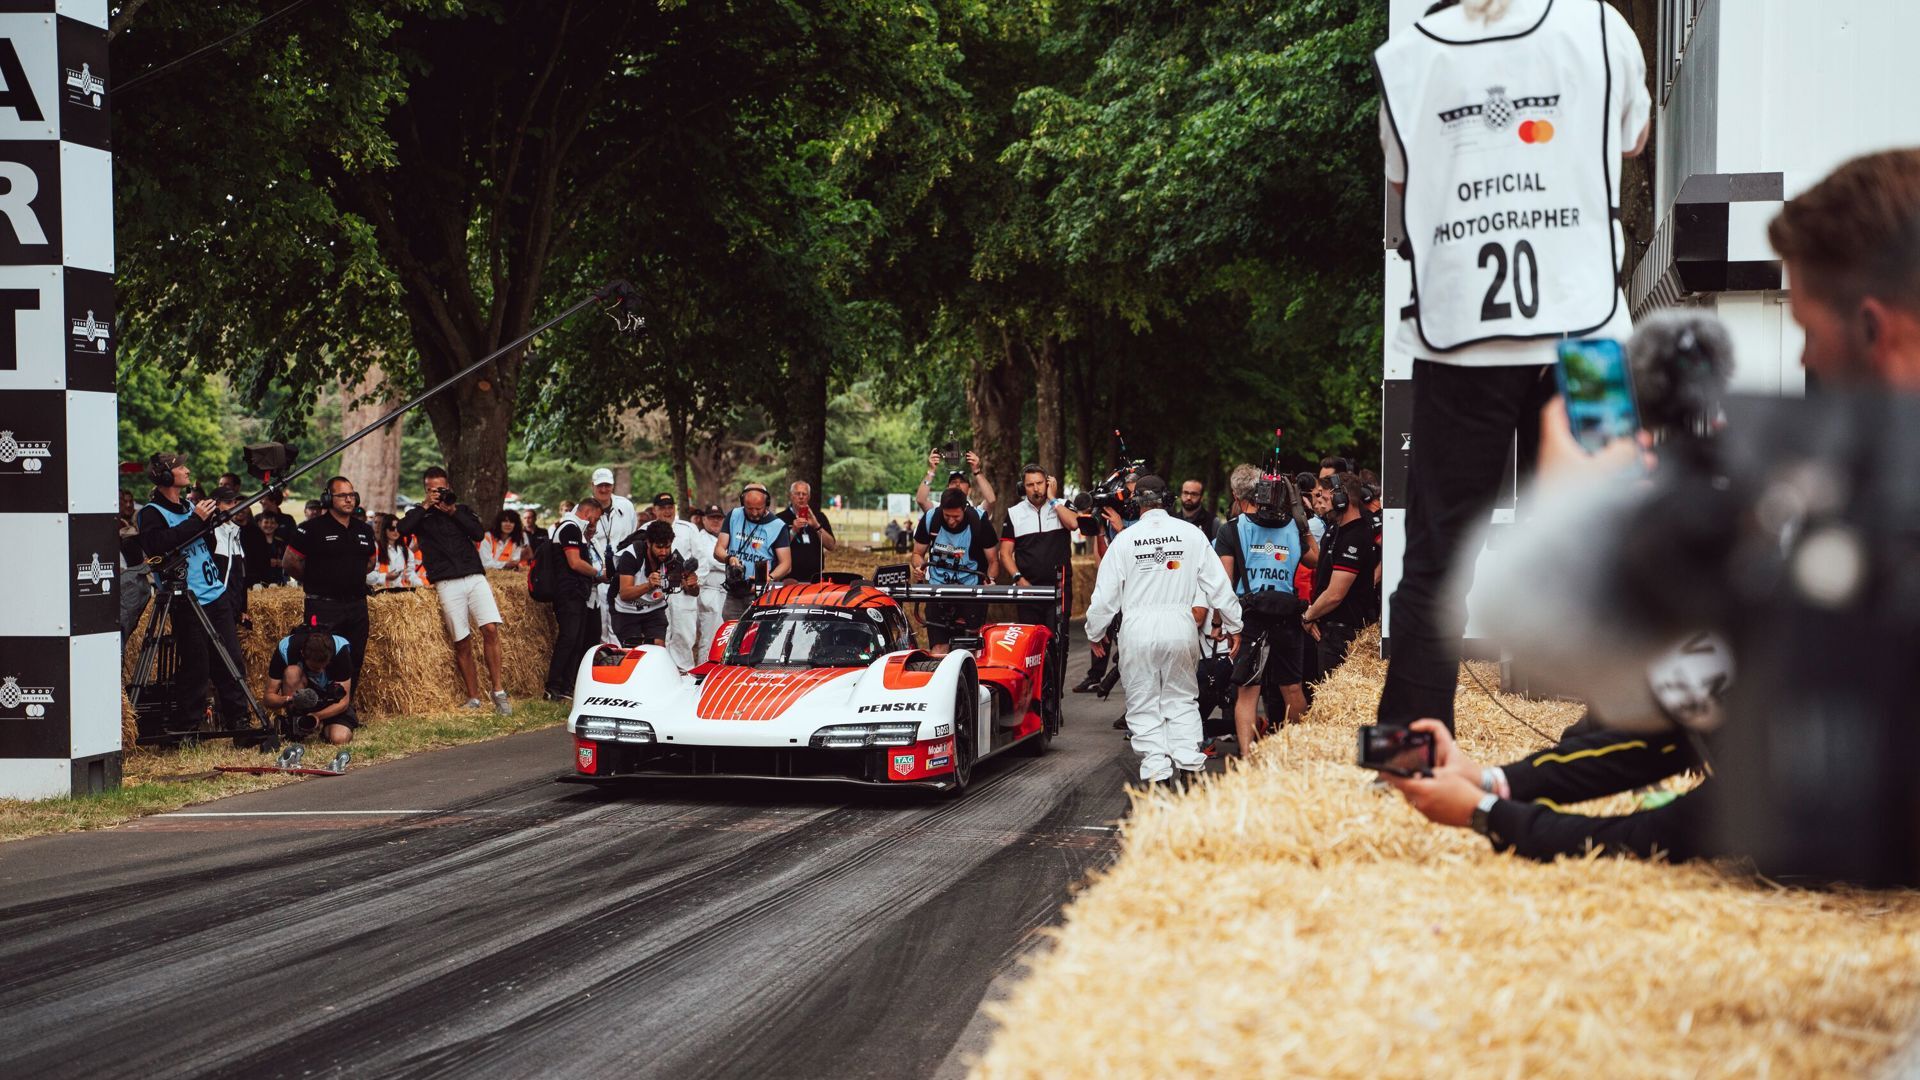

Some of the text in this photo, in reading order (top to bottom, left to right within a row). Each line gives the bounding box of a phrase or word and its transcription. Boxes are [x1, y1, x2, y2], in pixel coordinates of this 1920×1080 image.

[1458, 173, 1546, 202] OFFICIAL
[1477, 239, 1540, 323] 20
[1133, 535, 1183, 547] MARSHAL
[877, 571, 906, 586] PORSCHE
[752, 608, 853, 620] PORSCHE
[583, 696, 643, 709] PENSKE
[858, 702, 928, 714] PENSKE
[936, 725, 950, 736] BOSS
[895, 756, 914, 764] TAG
